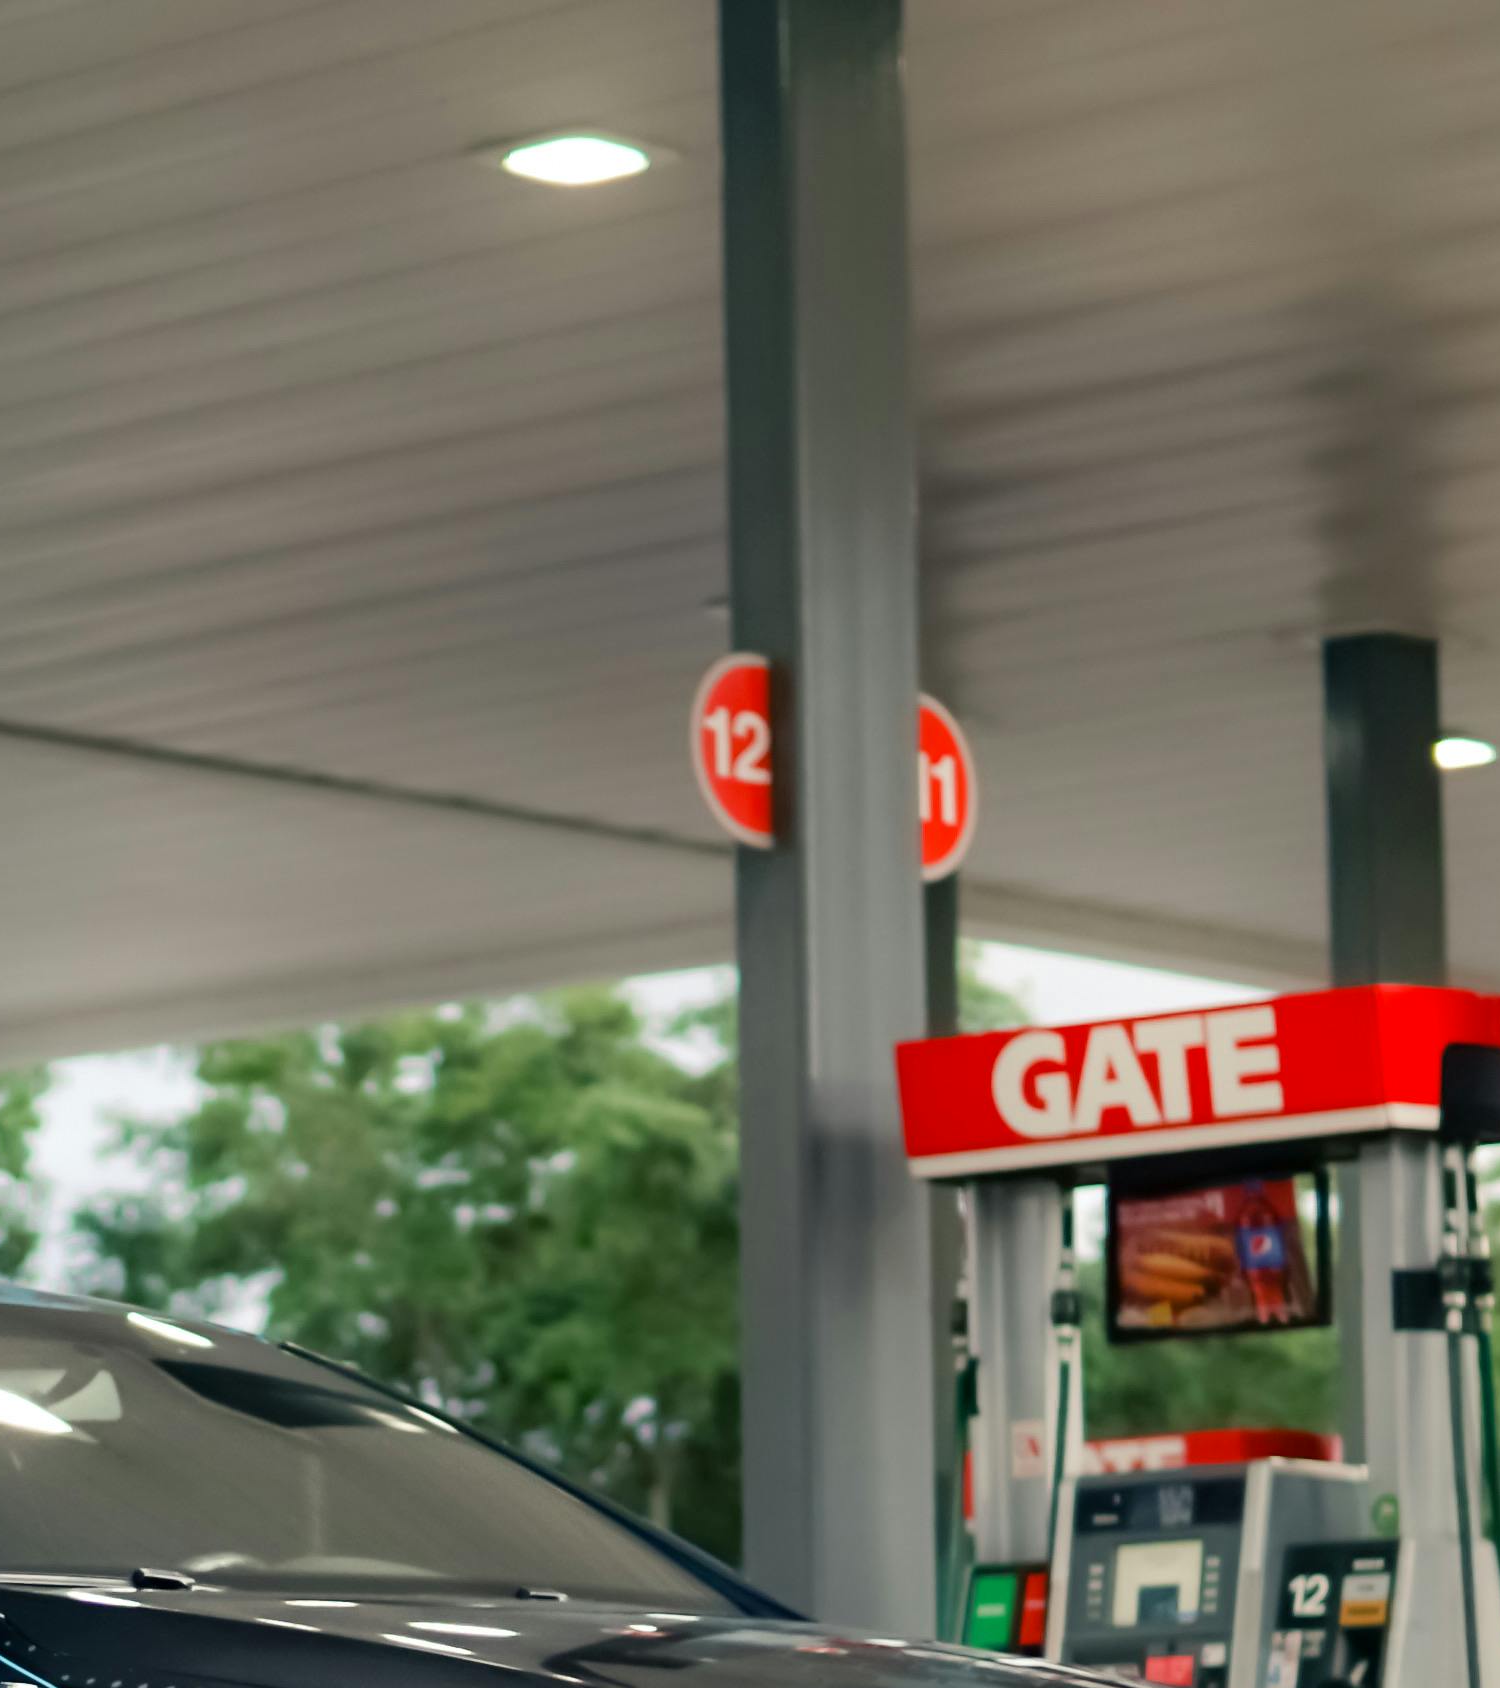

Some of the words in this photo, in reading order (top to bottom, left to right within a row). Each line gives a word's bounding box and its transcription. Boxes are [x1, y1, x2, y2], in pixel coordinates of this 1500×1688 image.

[703, 706, 771, 785] 12
[992, 1005, 1283, 1139] GATE
[1289, 1572, 1330, 1618] 12
